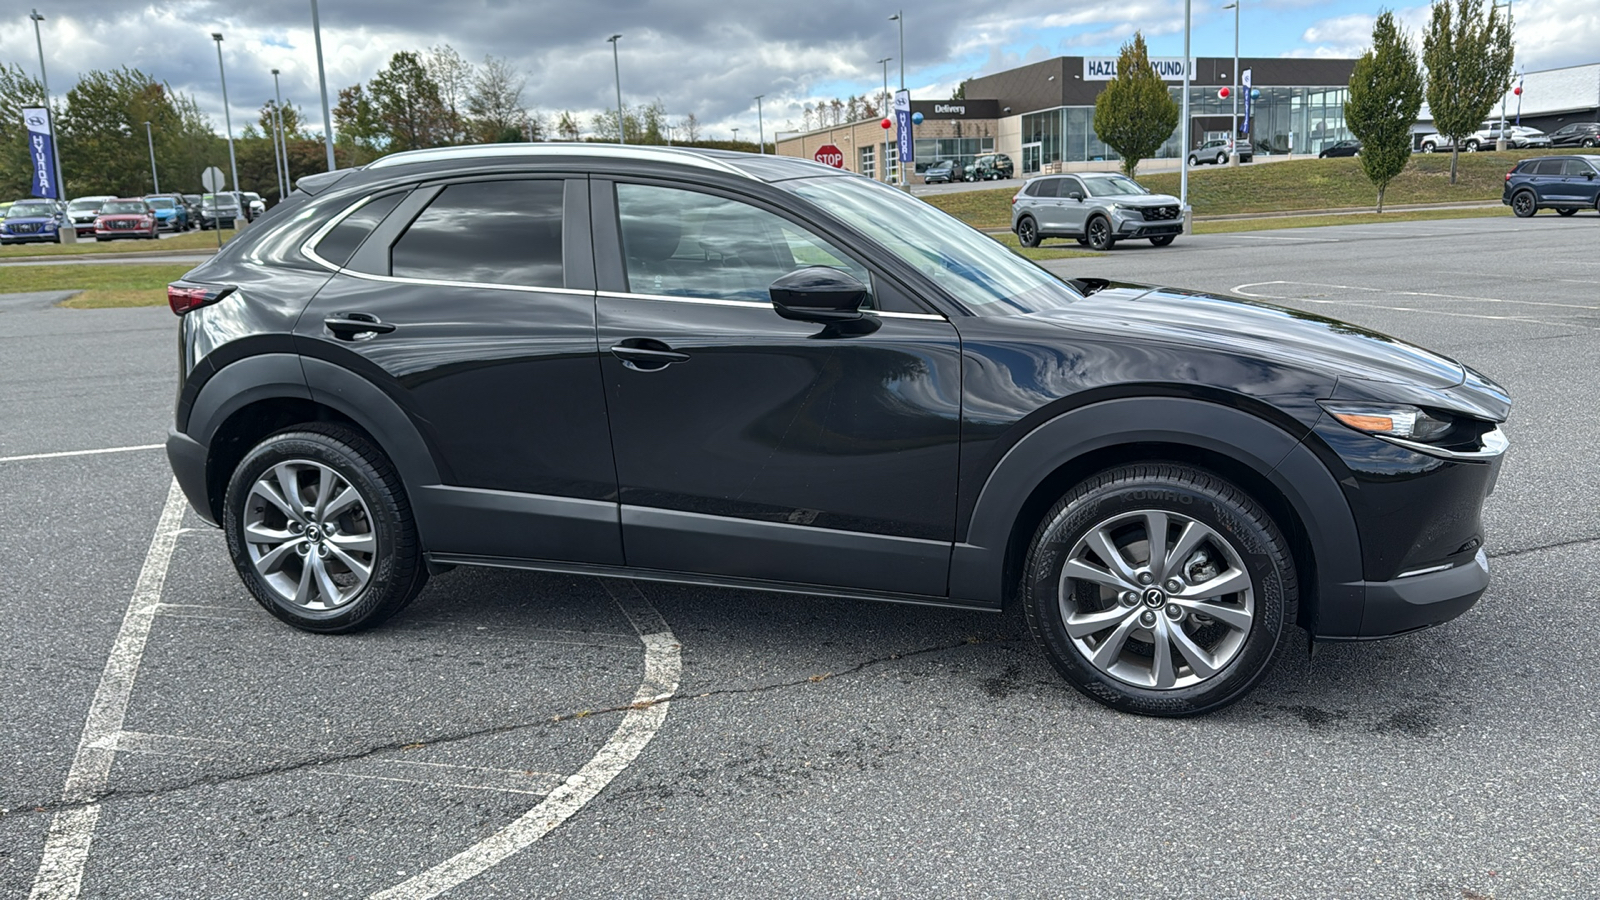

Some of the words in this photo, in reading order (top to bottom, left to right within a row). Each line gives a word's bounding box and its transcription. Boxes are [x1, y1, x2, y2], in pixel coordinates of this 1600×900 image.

[1147, 61, 1192, 75] YUNDI
[934, 104, 965, 115] Delivery
[900, 112, 908, 161] HYUNDAI
[33, 135, 50, 195] HYUNDAI
[816, 153, 842, 166] STOP
[1119, 489, 1193, 505] KUMHO
